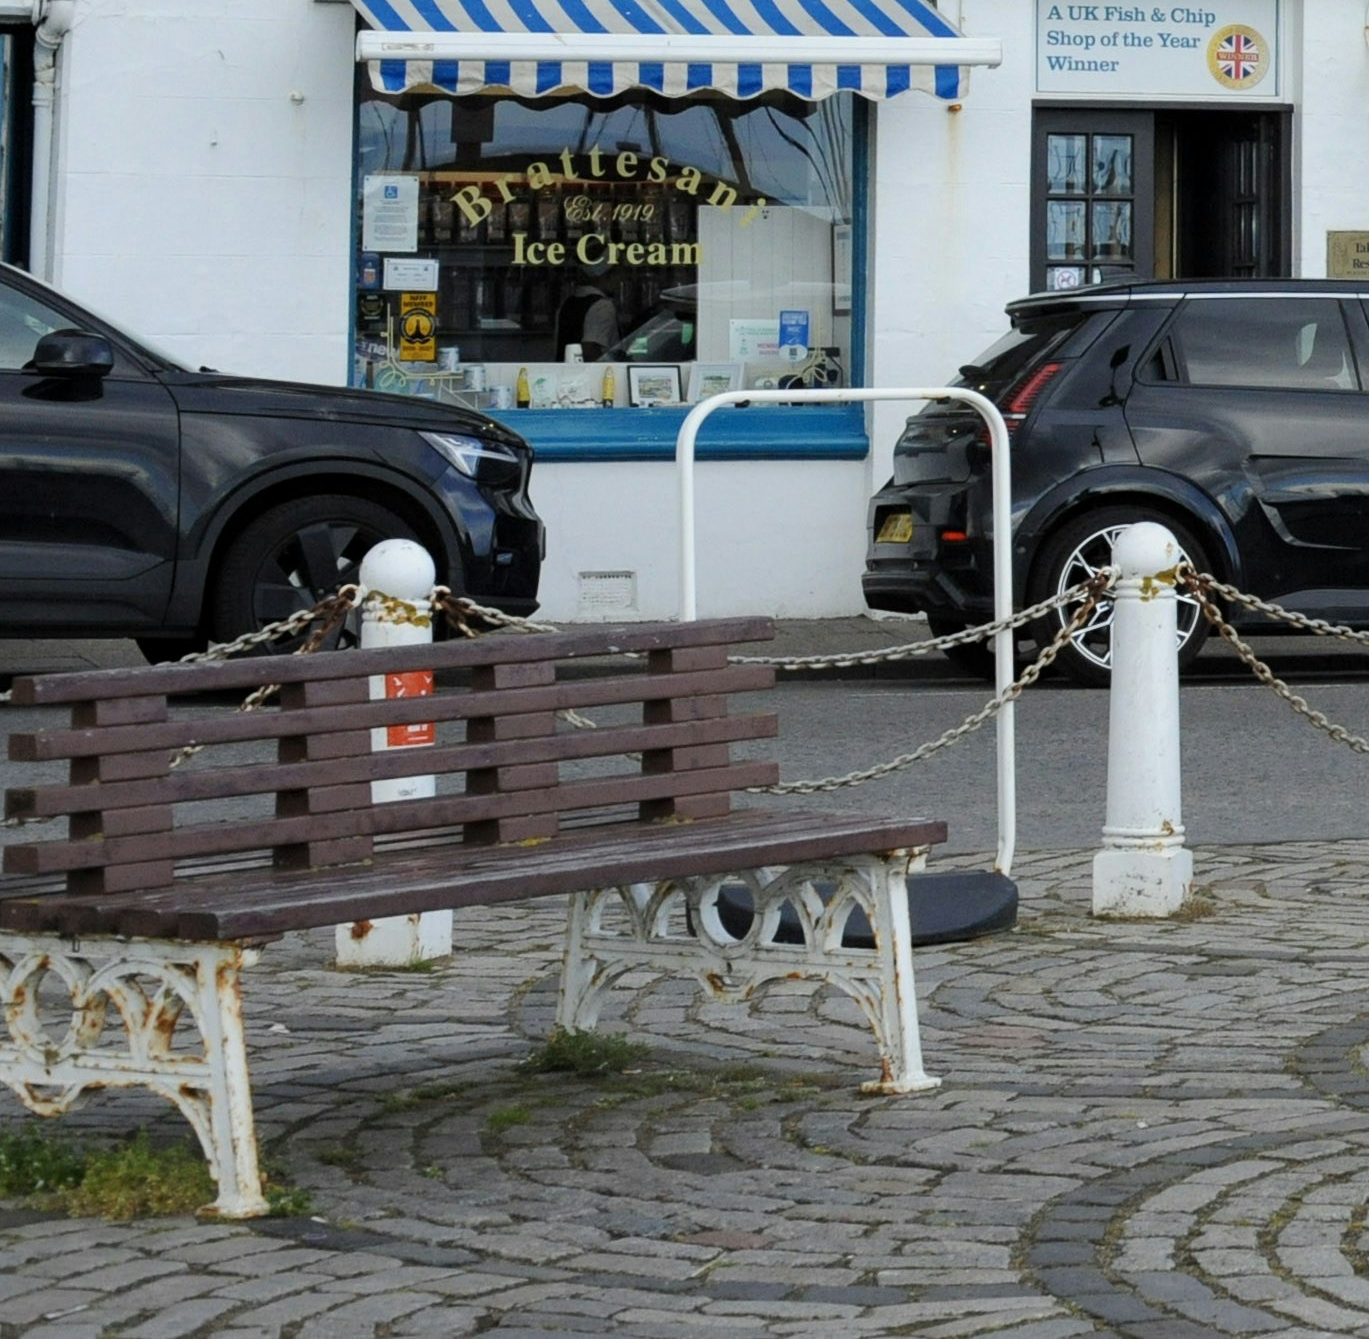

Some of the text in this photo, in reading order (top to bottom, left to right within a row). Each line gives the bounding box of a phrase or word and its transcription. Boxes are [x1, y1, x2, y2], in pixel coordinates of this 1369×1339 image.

[1046, 5, 1216, 28] A UK Fish & Chip
[1046, 30, 1201, 50] Shop of the Year
[1046, 55, 1120, 72] Winner
[1218, 52, 1258, 61] WINNER
[449, 143, 767, 228] Brattesani
[512, 233, 704, 265] Ice Cream
